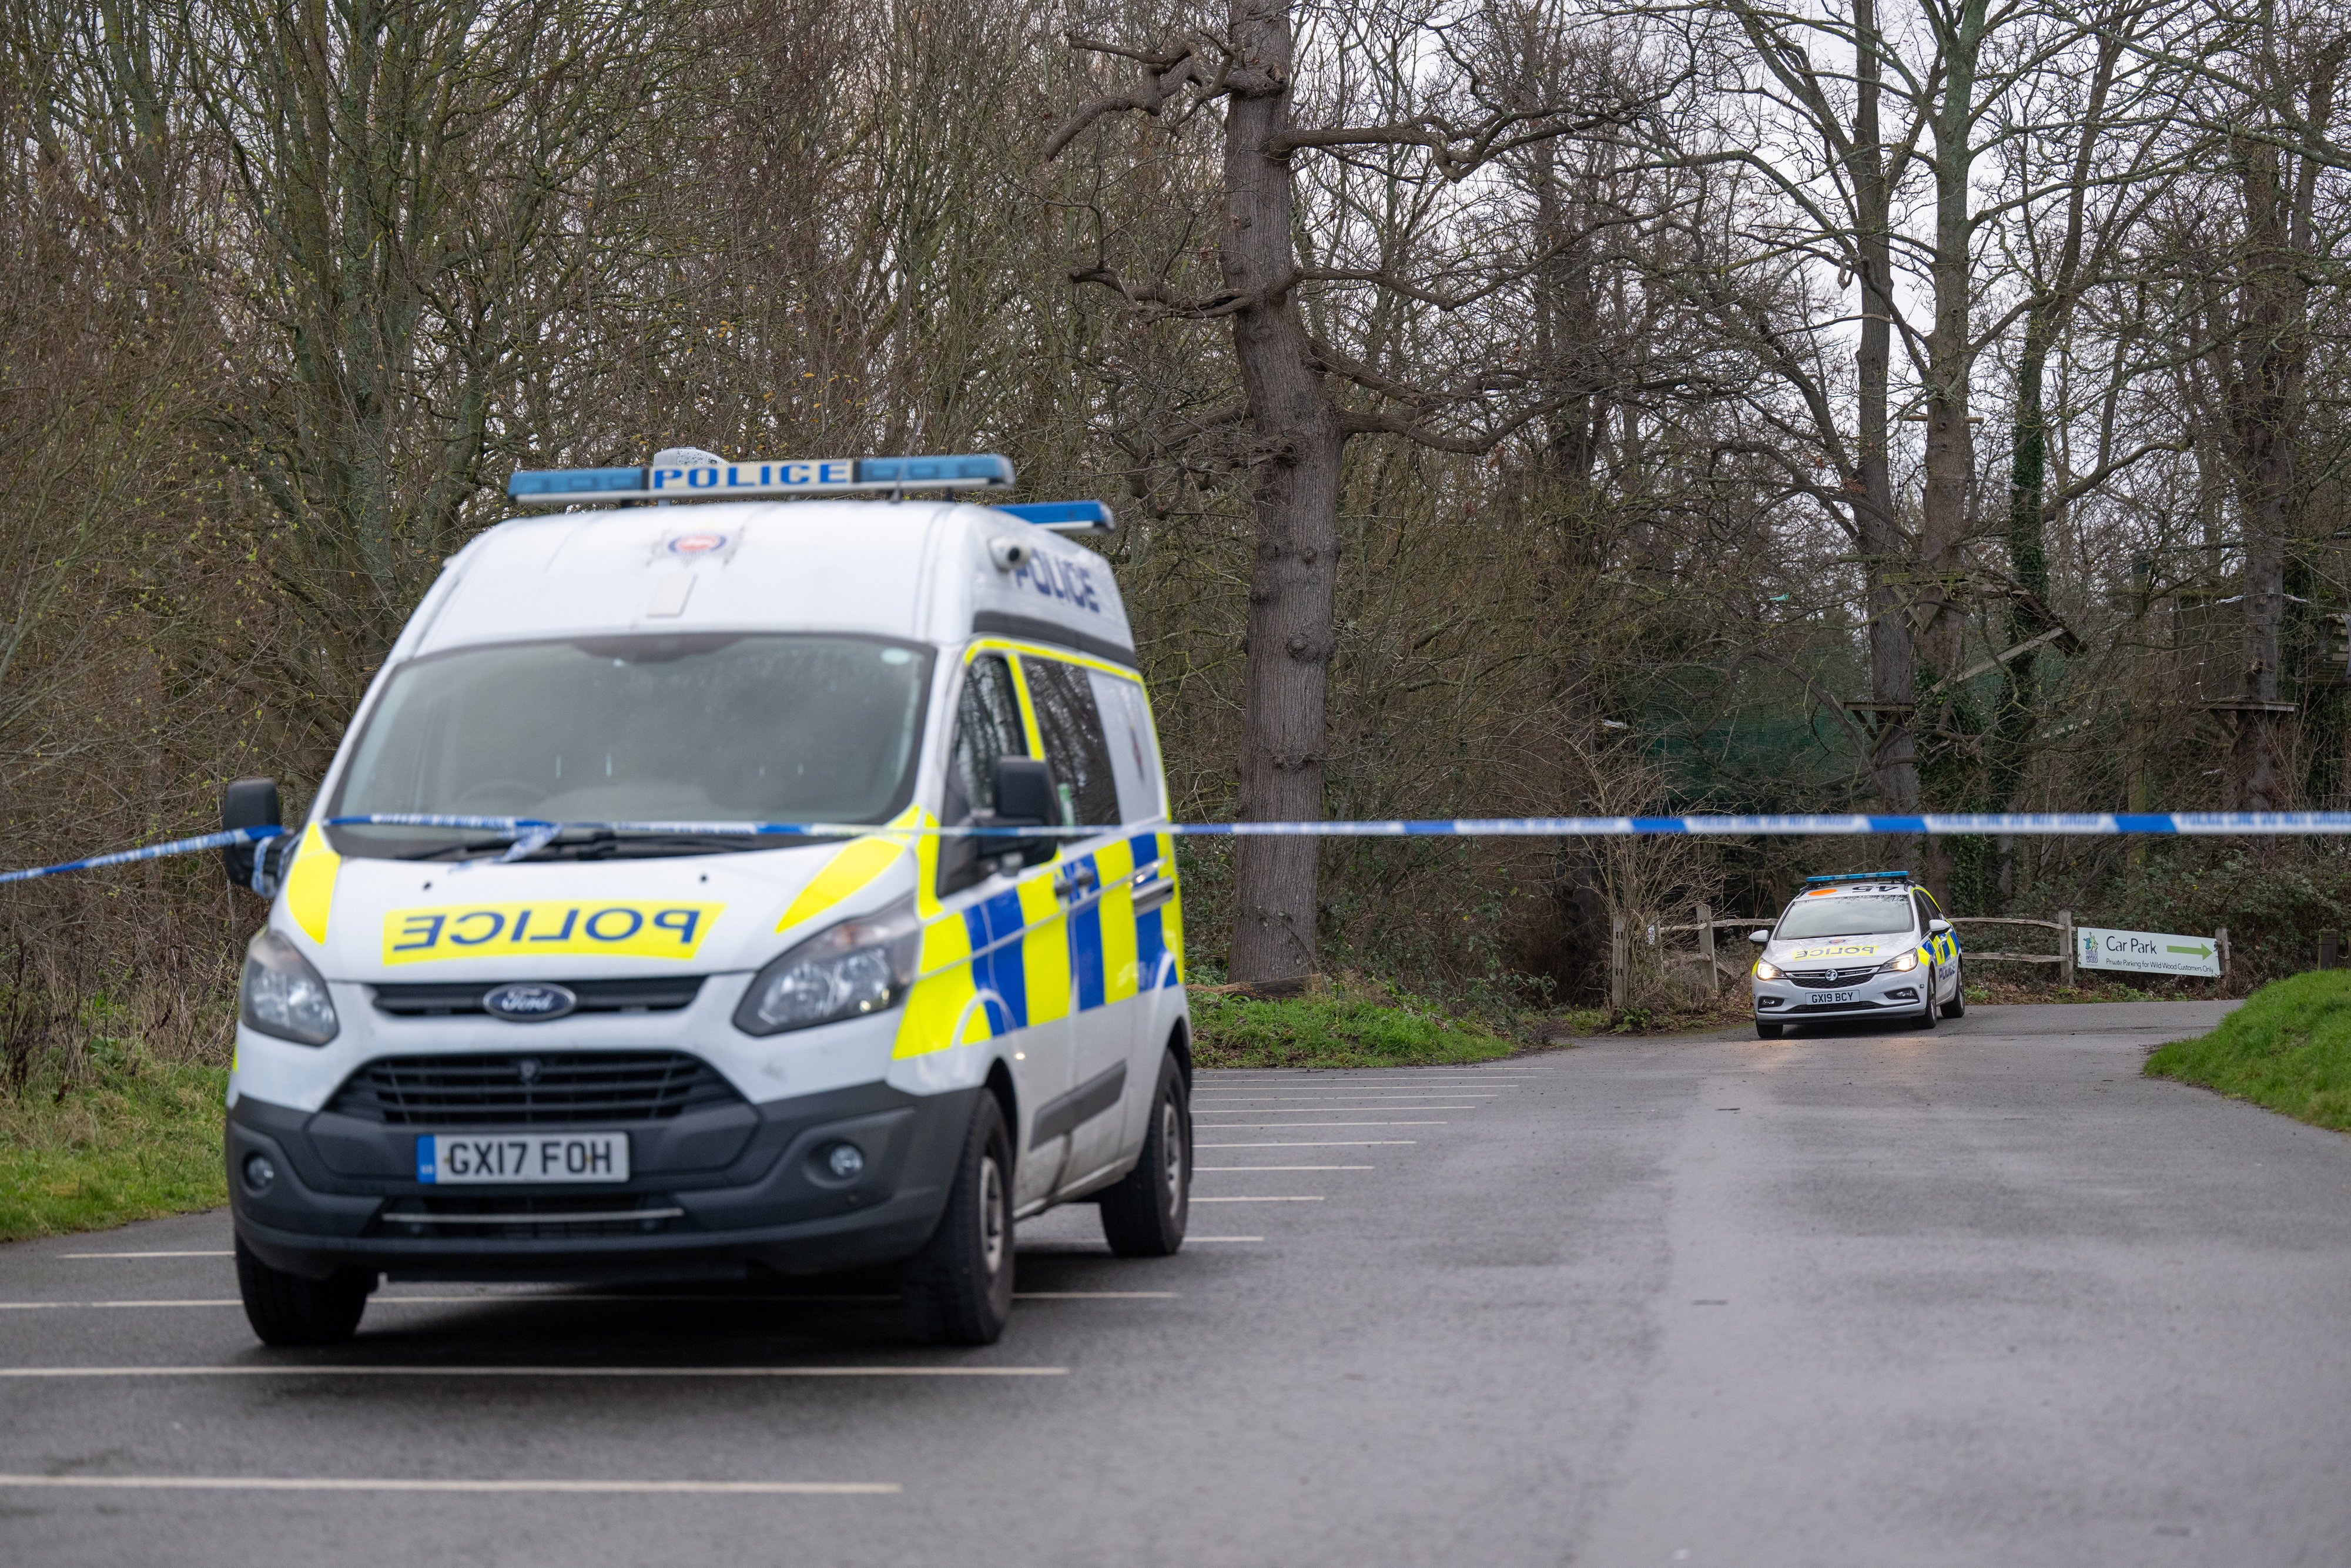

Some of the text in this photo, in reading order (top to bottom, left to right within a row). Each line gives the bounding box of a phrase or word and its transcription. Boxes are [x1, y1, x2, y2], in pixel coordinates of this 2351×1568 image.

[653, 461, 847, 490] POLICE
[2106, 936, 2156, 954] Car Park
[2123, 960, 2141, 969] Parking
[2178, 963, 2202, 971] Customers
[2202, 965, 2213, 974] Only
[501, 987, 554, 1011] Ford
[1812, 992, 1853, 1003] GX19 BCY
[449, 1142, 611, 1175] GX17 FOH
